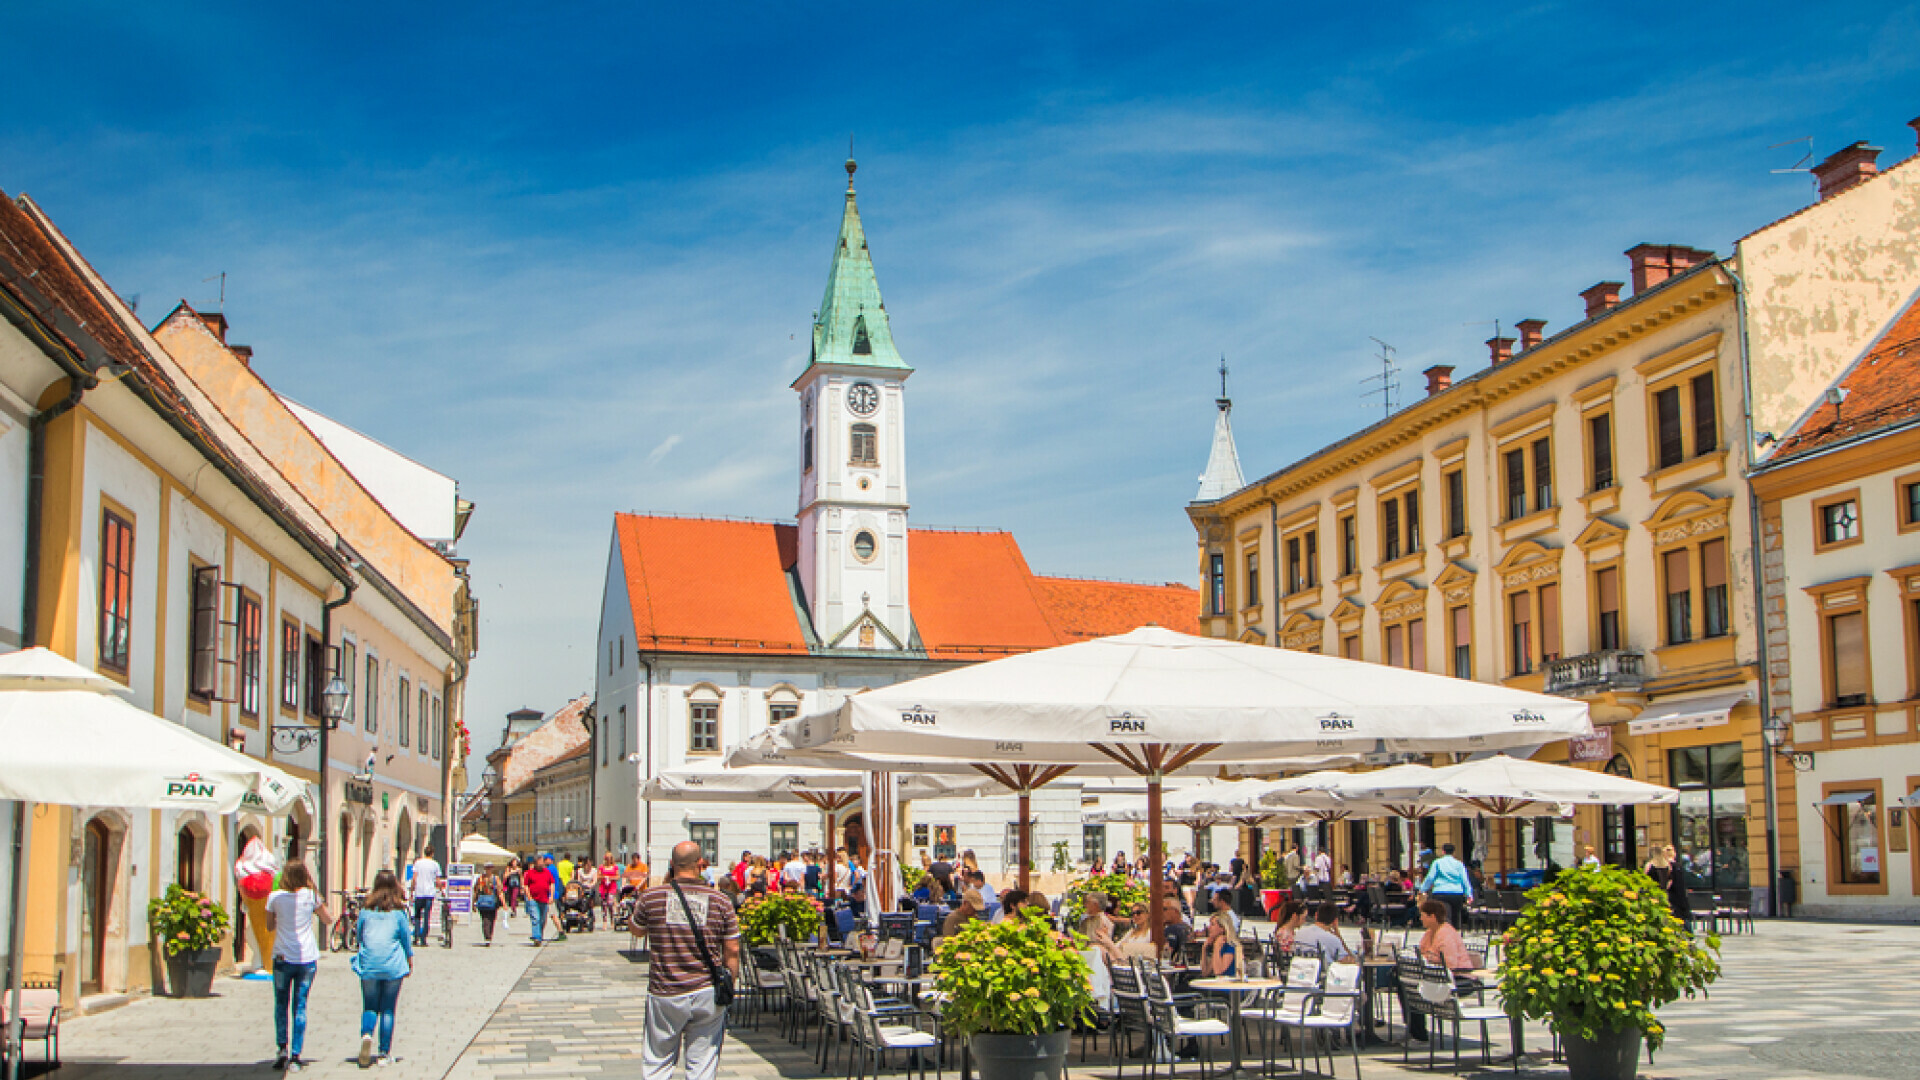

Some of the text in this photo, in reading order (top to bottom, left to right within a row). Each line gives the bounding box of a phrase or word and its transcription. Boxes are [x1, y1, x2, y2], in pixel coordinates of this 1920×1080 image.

[902, 712, 936, 725] PAN
[1320, 719, 1354, 730] PAN
[1110, 719, 1145, 732] PAN
[167, 782, 215, 797] PAN
